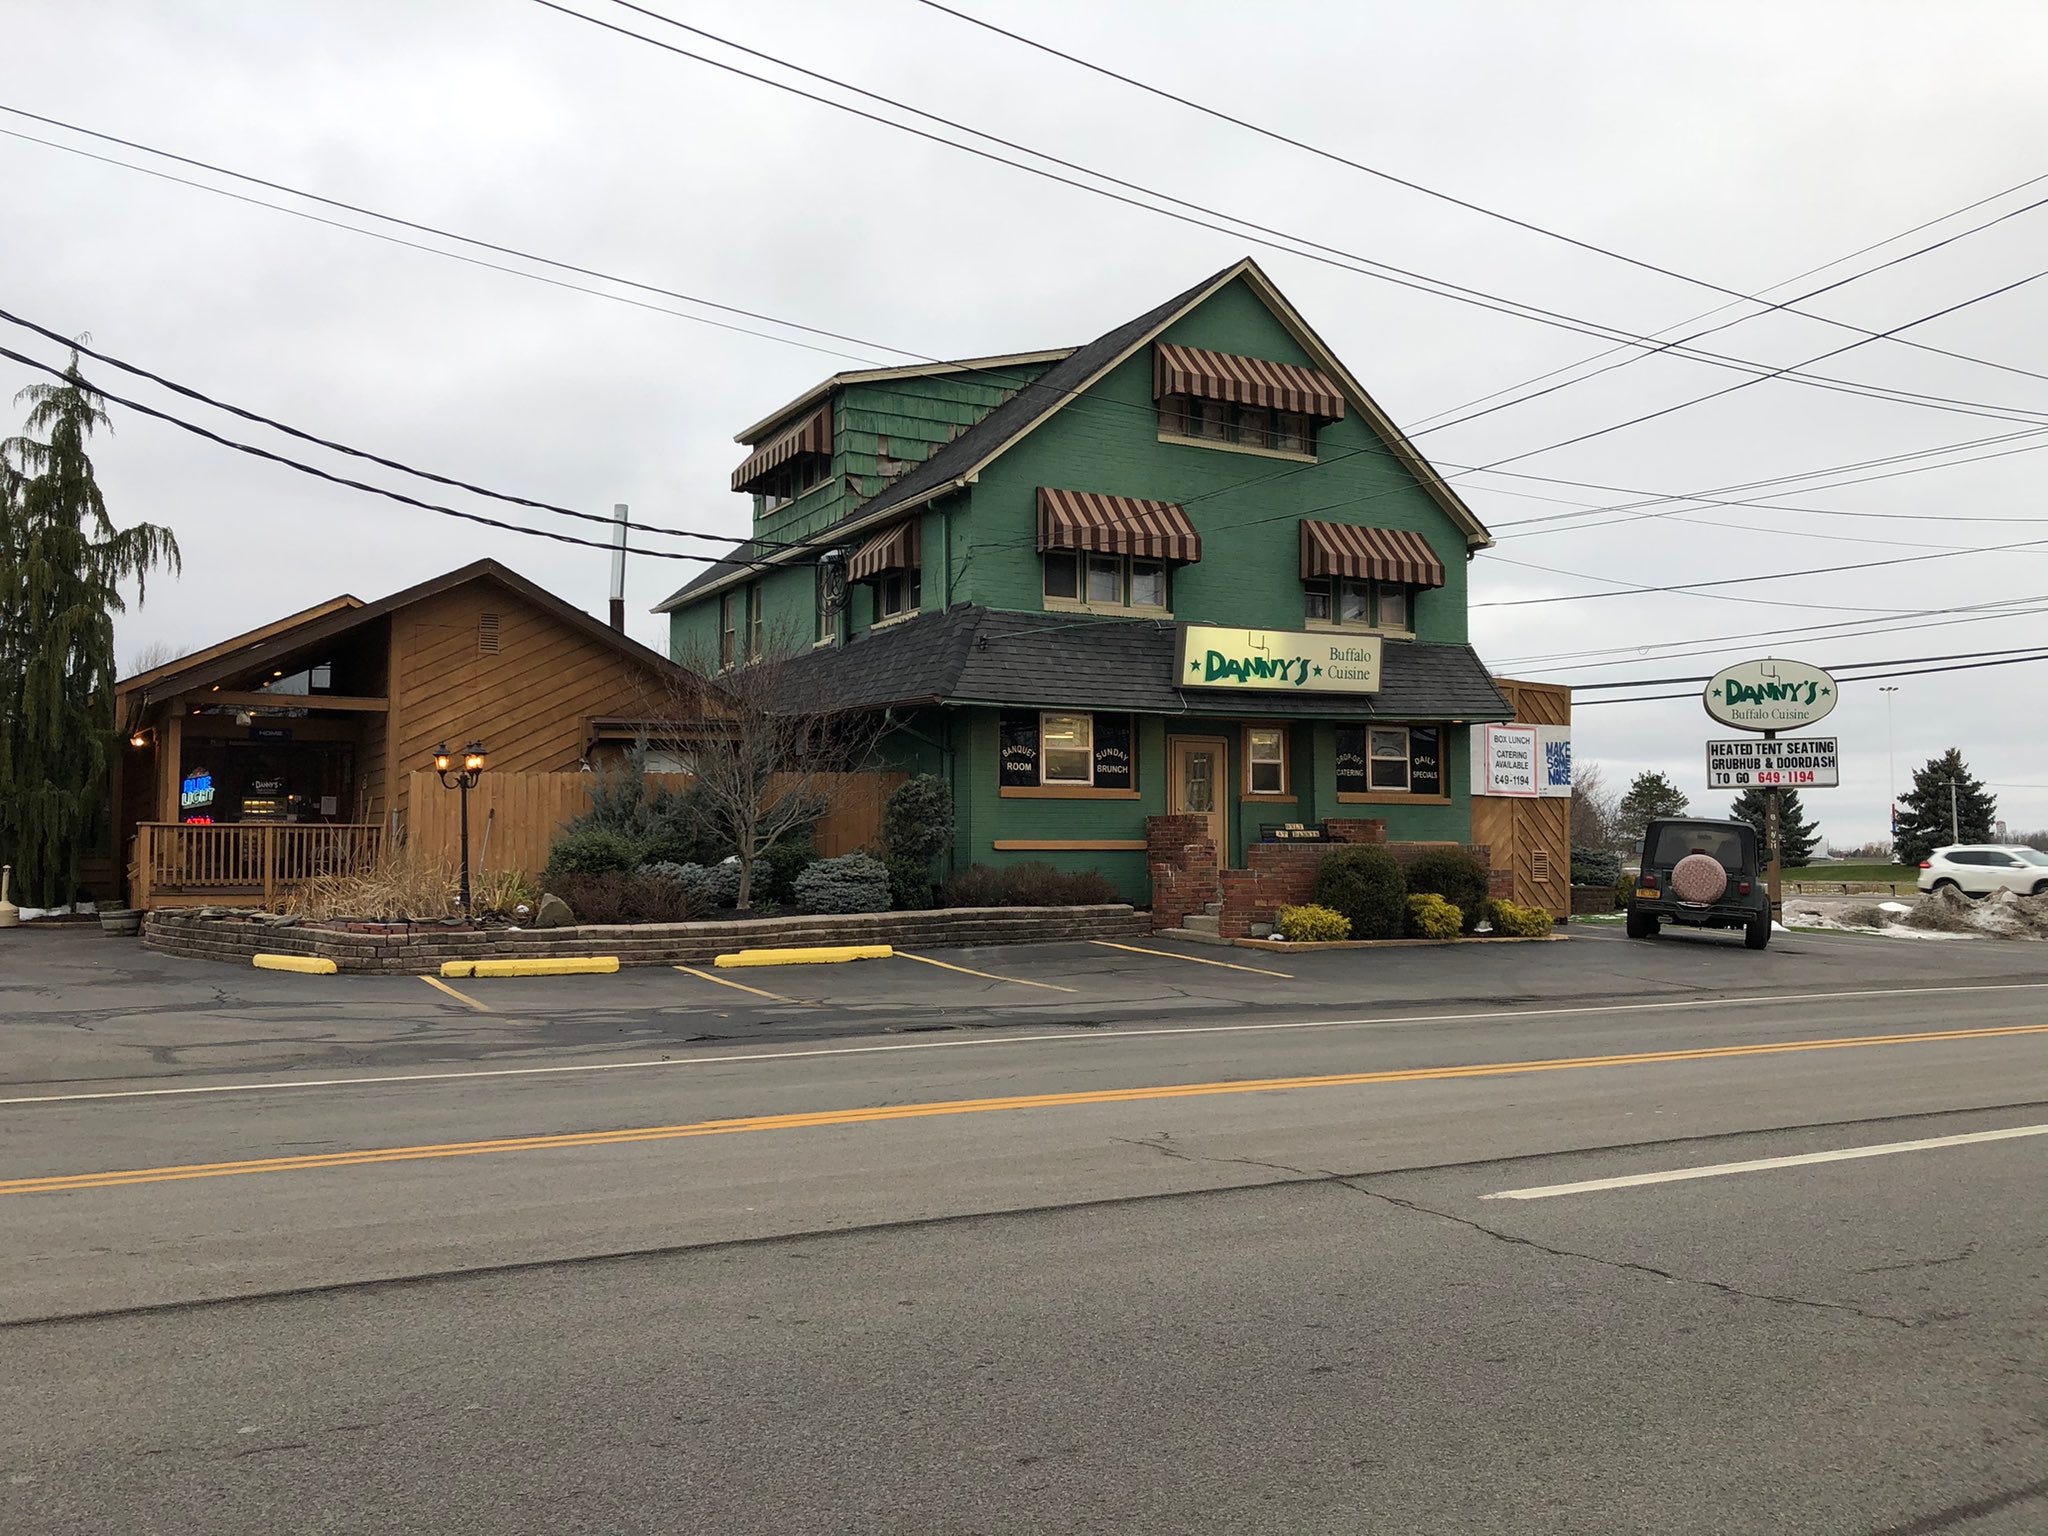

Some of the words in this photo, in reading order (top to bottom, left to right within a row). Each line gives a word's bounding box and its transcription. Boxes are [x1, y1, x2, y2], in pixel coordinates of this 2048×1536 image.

[1330, 647, 1371, 662] Buffalo
[1204, 650, 1311, 686] DANNY'S
[1328, 665, 1370, 680] Cuisine
[1726, 679, 1819, 706] DANNY'S
[1732, 709, 1769, 719] Buffalo
[1771, 709, 1809, 719] Cuisine
[1494, 735, 1507, 743] BOX
[1509, 736, 1531, 744] LUNCH
[1002, 745, 1036, 759] BANQUET
[1096, 748, 1128, 761] SUNDAY
[1496, 750, 1527, 759] CATERING
[1546, 741, 1570, 758] MAKE
[1711, 744, 1753, 756] HEATED
[1756, 743, 1782, 754] TENT
[1787, 741, 1834, 754] SEATING
[1006, 762, 1032, 771] ROOM
[1414, 756, 1435, 765] DAILY
[1495, 761, 1528, 769] AVAILABLE
[1712, 758, 1761, 770] GRUBHUB
[1765, 758, 1773, 768] &
[1777, 756, 1835, 769] DOORDASH
[1097, 764, 1128, 774] BRUNCH
[1413, 771, 1437, 779] SPECIALS
[1495, 775, 1529, 785] 649-1194
[1548, 769, 1571, 786] NOISE
[1716, 773, 1730, 784] TO
[1736, 773, 1749, 783] GO
[184, 776, 211, 793] BLUE
[181, 788, 215, 806] LIGHT
